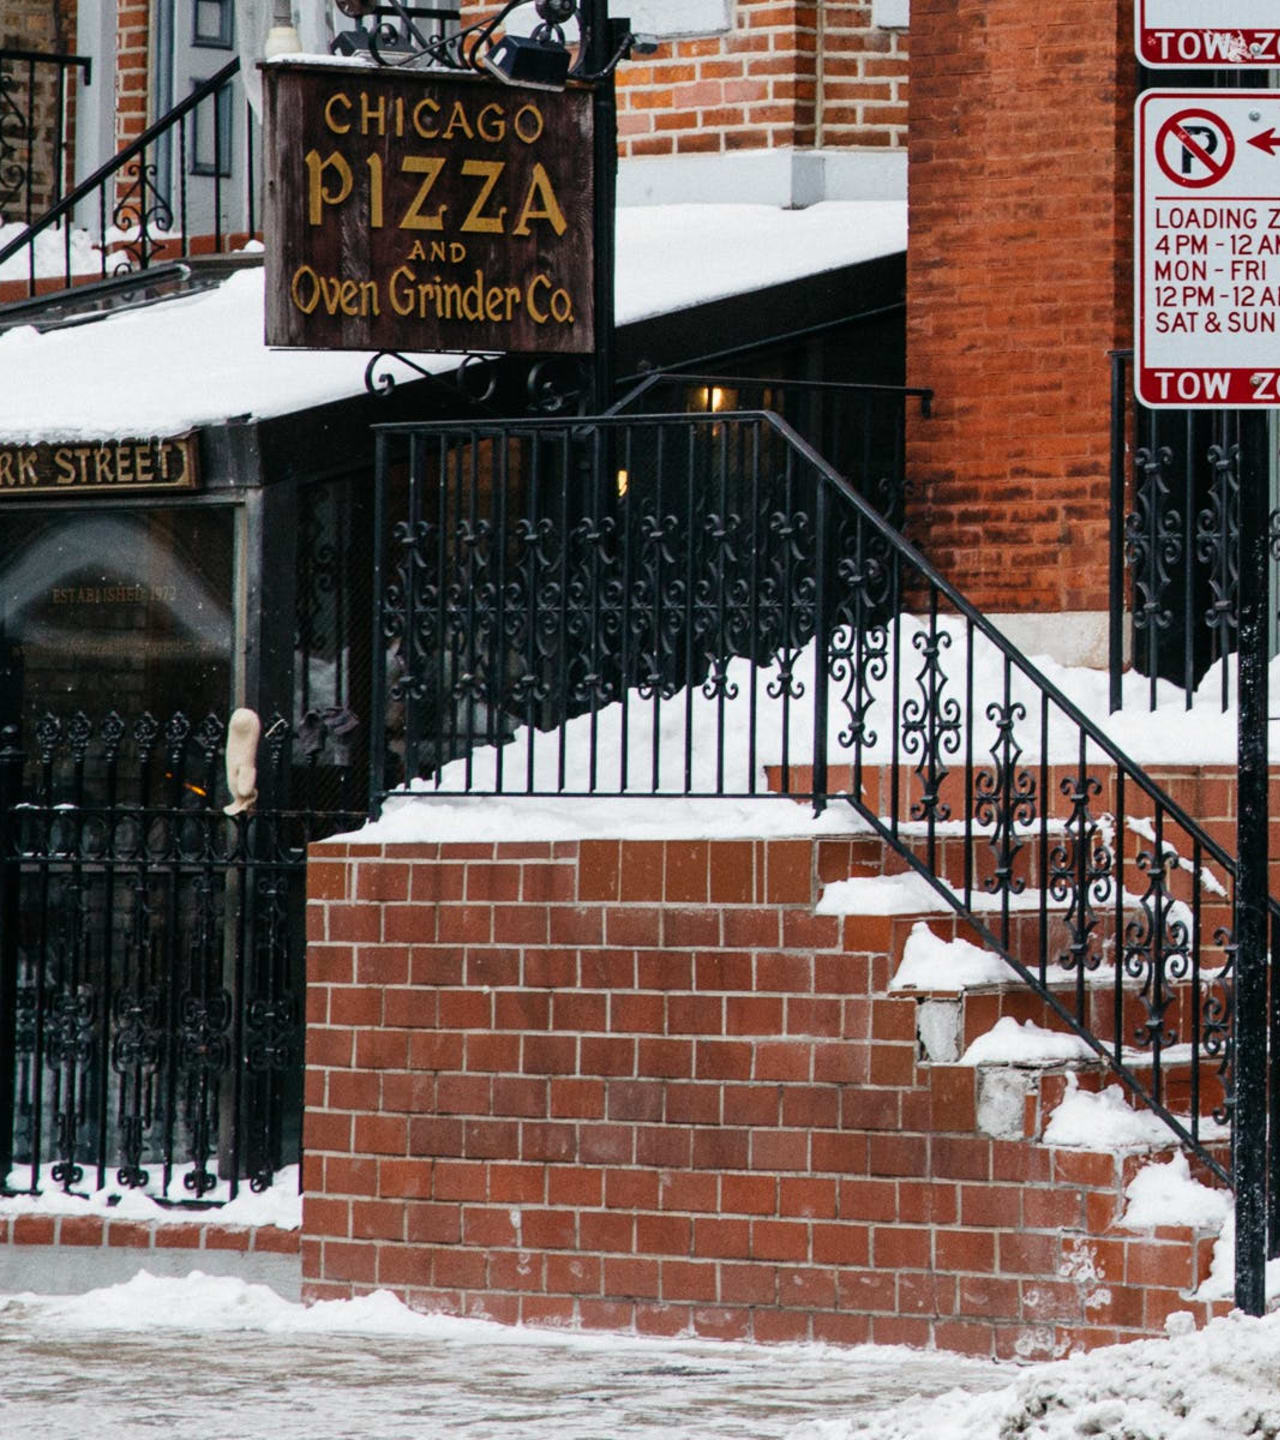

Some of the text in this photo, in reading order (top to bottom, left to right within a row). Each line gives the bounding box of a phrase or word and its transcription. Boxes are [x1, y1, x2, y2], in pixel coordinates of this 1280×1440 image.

[1155, 32, 1231, 59] TOW
[325, 92, 543, 144] CHICAGO
[305, 149, 567, 236] PIZZA
[1156, 208, 1257, 230] LOADING
[408, 240, 466, 263] AND
[1155, 260, 1206, 281] MON
[1231, 260, 1266, 281] FRI
[292, 266, 574, 323] Oven Grinder Co.
[1156, 312, 1276, 333] SAT & SUN
[1154, 372, 1231, 400] TOW
[54, 444, 172, 484] STREET
[53, 587, 143, 603] ESTABLISHED
